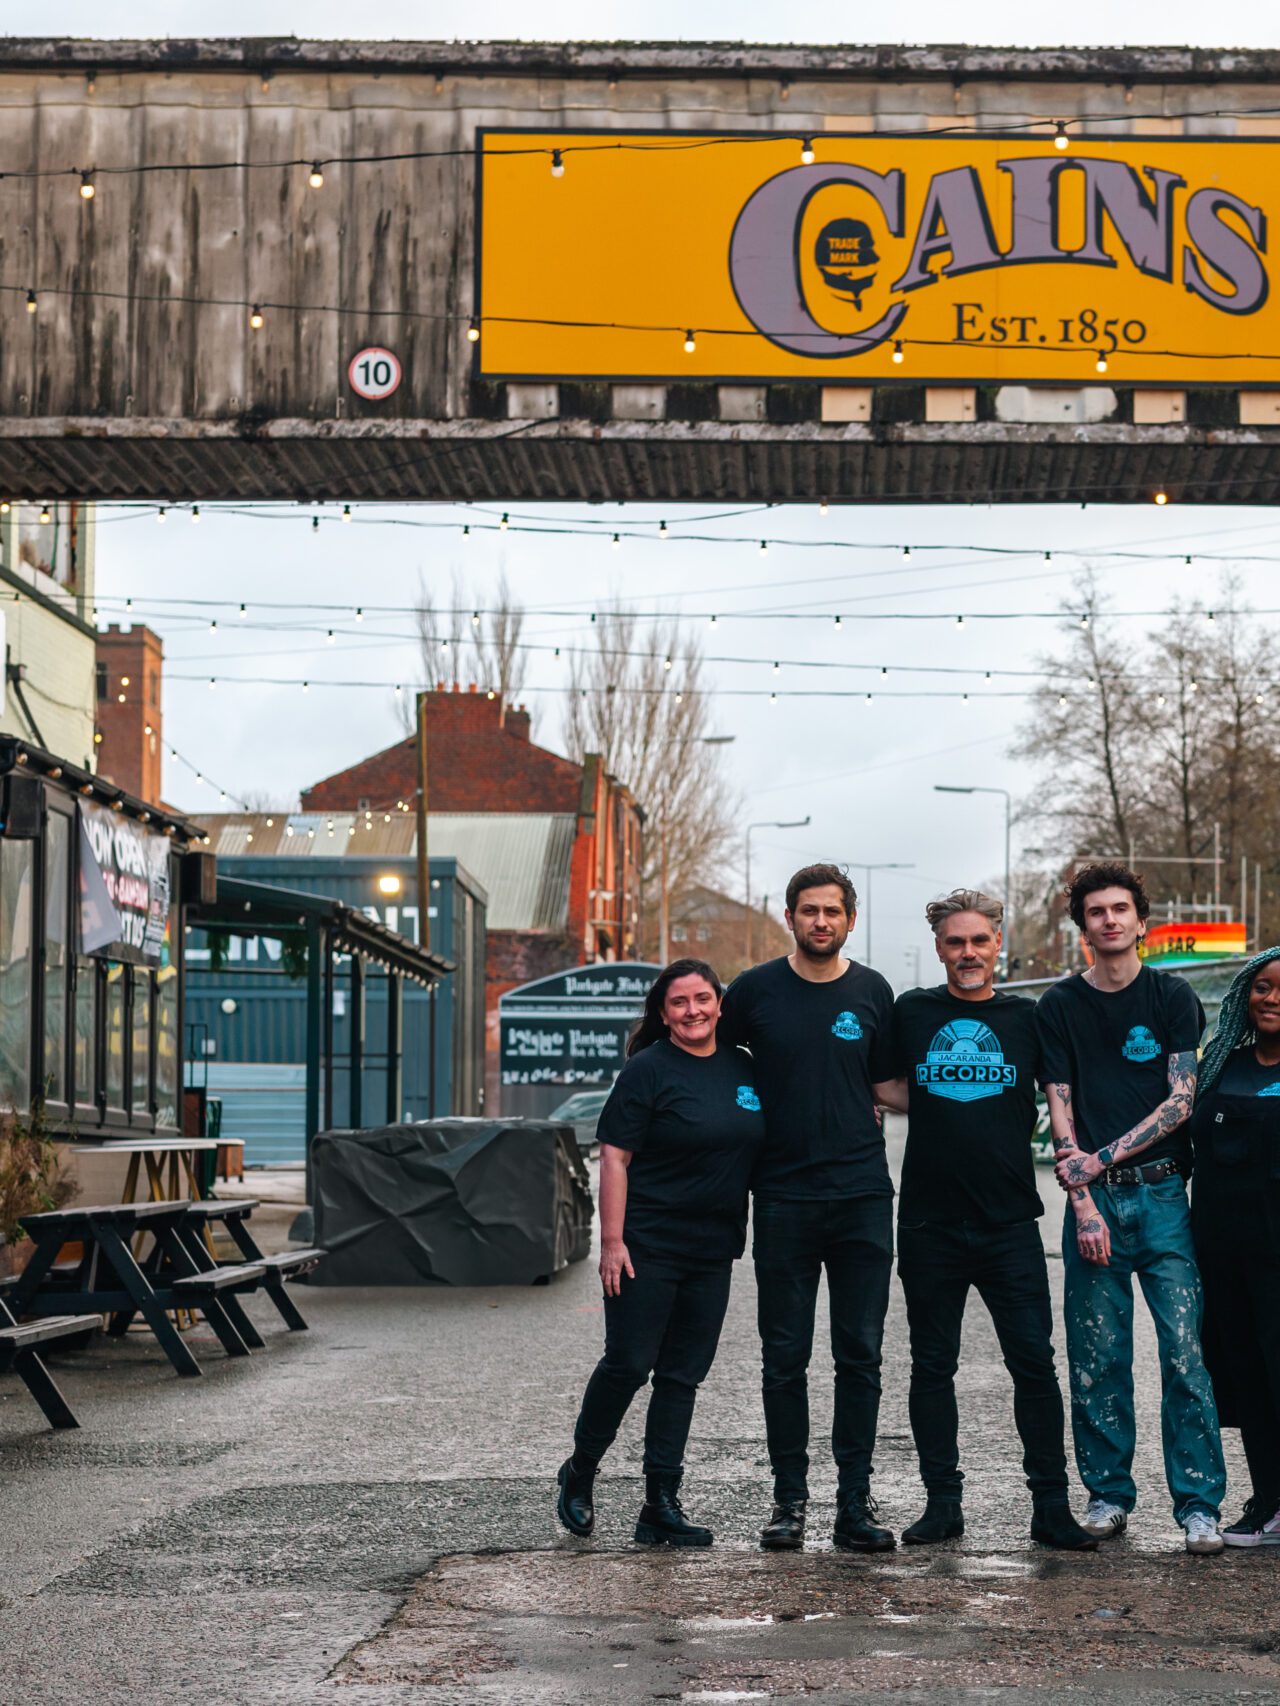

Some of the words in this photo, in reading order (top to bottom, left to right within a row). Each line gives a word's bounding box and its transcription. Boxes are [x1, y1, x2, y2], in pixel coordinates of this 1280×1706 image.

[828, 237, 860, 250] TRADE
[728, 156, 1271, 360] CAINS
[830, 252, 859, 263] MARK
[1058, 308, 1147, 355] 1850
[358, 360, 391, 386] 10
[114, 829, 148, 879] OPEN
[938, 1054, 992, 1063] JACARANDA
[919, 1065, 1013, 1083] RECORDS
